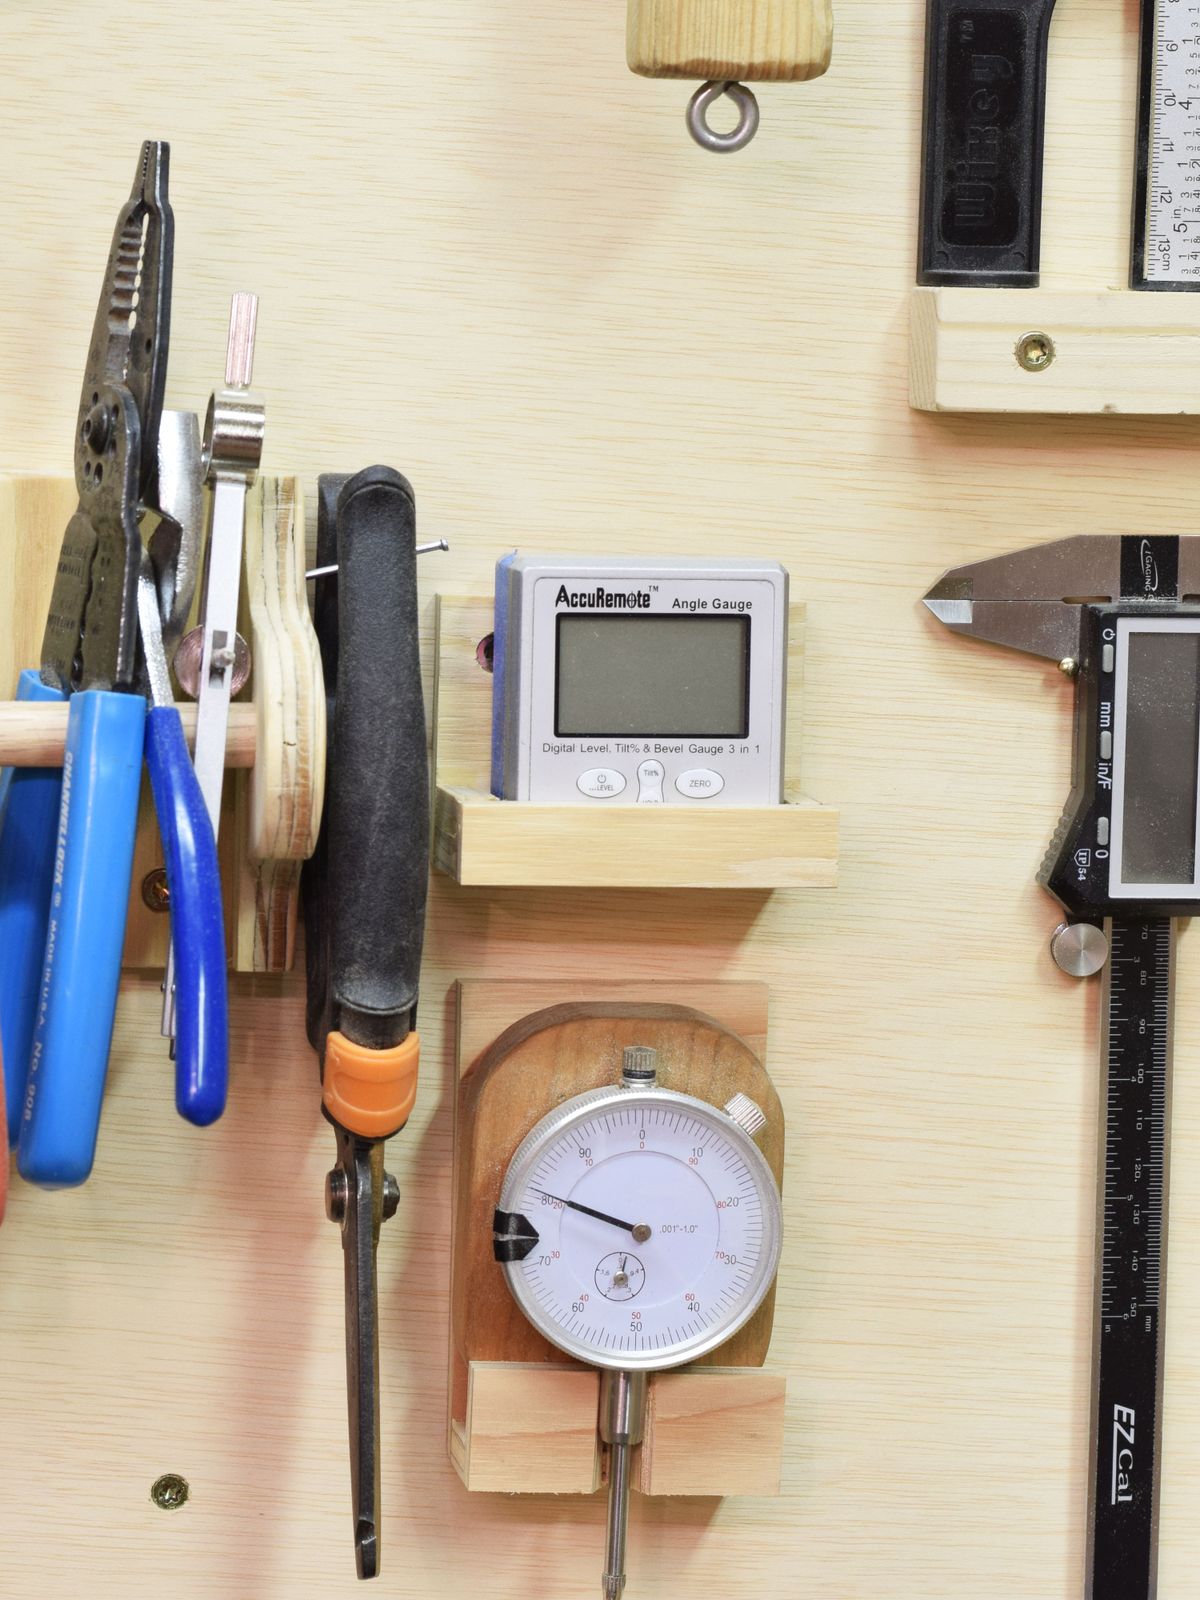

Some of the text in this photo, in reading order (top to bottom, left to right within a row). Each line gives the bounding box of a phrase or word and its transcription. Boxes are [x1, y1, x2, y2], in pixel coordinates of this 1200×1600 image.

[1164, 93, 1176, 107] 10
[1178, 100, 1193, 111] 4
[1162, 141, 1175, 152] 11
[1160, 190, 1173, 204] 12
[1173, 223, 1188, 233] 5
[555, 584, 650, 609] AccuRemote
[672, 598, 753, 612] Angle Gauge
[1100, 701, 1112, 728] mm
[542, 743, 576, 755] Digital
[615, 743, 640, 754] Tilt%
[643, 744, 652, 754] &
[654, 743, 684, 754] Bevel
[688, 744, 724, 756] Gauge
[729, 744, 736, 754] 3
[740, 744, 750, 754] in
[756, 744, 761, 754] 1
[1097, 762, 1112, 790] in/F
[689, 780, 711, 788] ZERO
[54, 751, 73, 888] CHANNELLOCK
[46, 919, 57, 963] MADE
[1138, 1018, 1146, 1035] 90
[1137, 1063, 1145, 1084] 100
[639, 1129, 646, 1140] 0
[579, 1148, 591, 1158] 90
[692, 1147, 704, 1158] 10
[541, 1195, 554, 1205] 80
[726, 1197, 739, 1207] 20
[539, 1255, 551, 1266] 70
[724, 1255, 737, 1265] 30
[1131, 1250, 1139, 1272] 140
[571, 1302, 584, 1313] 60
[687, 1302, 700, 1312] 40
[630, 1321, 642, 1332] 50
